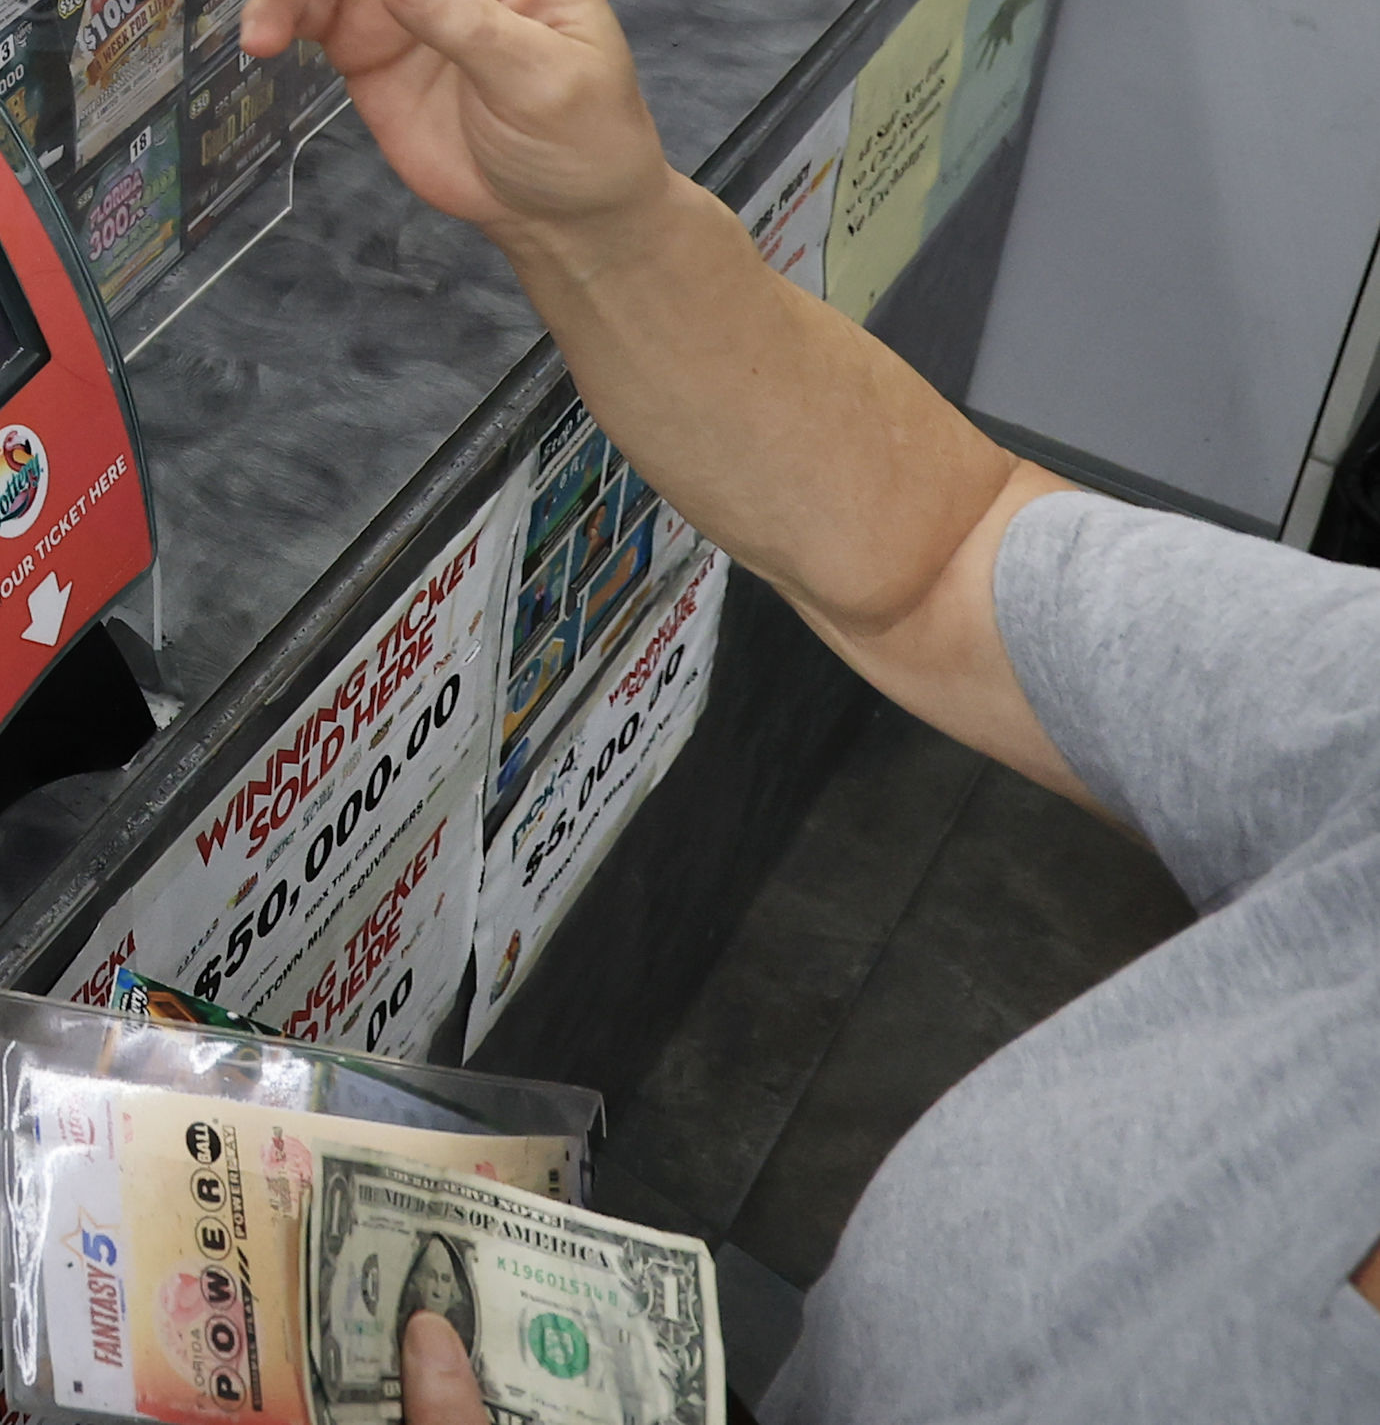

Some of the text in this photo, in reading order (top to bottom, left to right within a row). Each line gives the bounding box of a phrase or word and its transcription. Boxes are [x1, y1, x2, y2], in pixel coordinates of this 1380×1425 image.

[90, 169, 143, 226] FLORIDA
[33, 502, 88, 560] TICKET
[85, 455, 130, 505] HERE
[195, 528, 484, 867] WINNING TICKET
[245, 724, 345, 860] SOLD
[351, 614, 437, 743] HERE
[307, 897, 344, 950] MIAMI
[348, 798, 424, 900] SOUVENIERS
[344, 816, 447, 970] TICKET
[325, 907, 403, 1032] HERE
[82, 1230, 123, 1368] FANTASY 5
[500, 1217, 610, 1269] AMERICA
